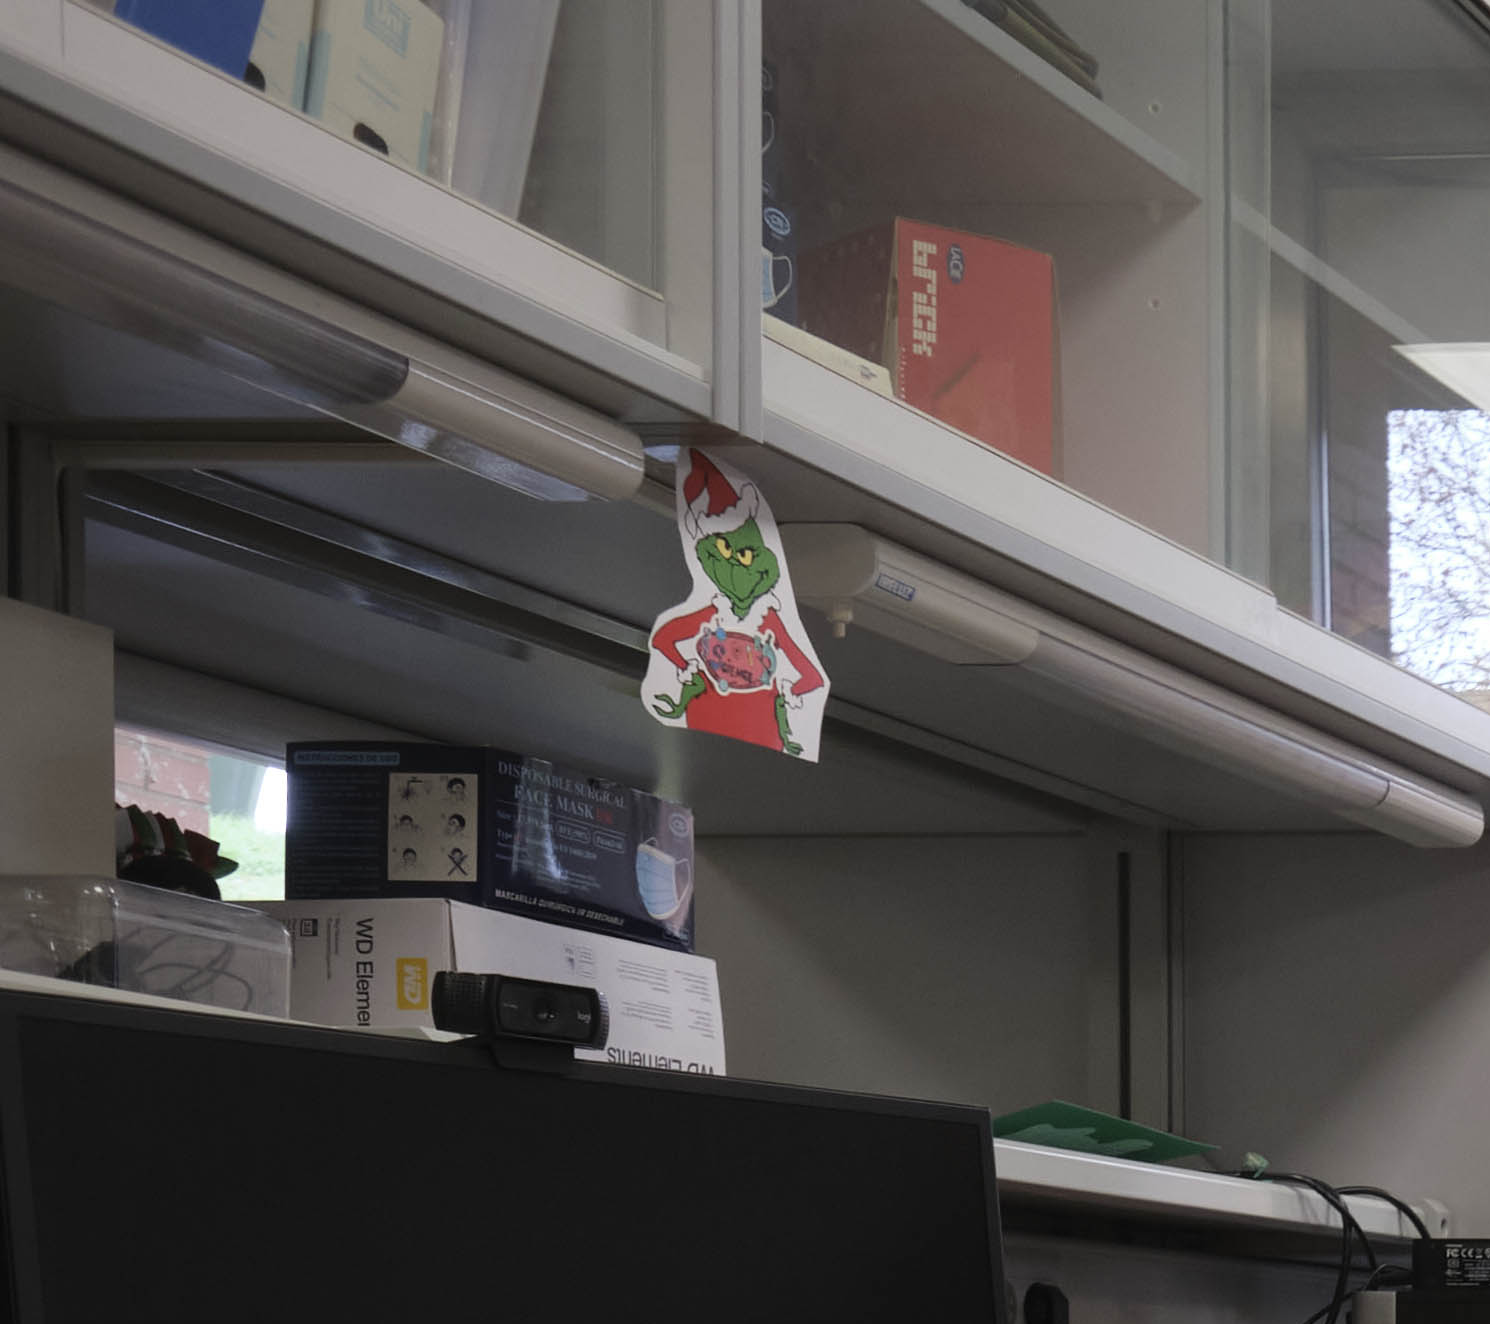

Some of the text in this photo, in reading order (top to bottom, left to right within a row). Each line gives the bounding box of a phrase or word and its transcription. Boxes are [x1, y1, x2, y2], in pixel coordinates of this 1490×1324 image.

[913, 240, 936, 357] brick
[497, 761, 627, 808] DISPOSABLE SURGICAL
[514, 784, 552, 807] FACE
[558, 796, 594, 819] MASK
[355, 918, 374, 955] WD
